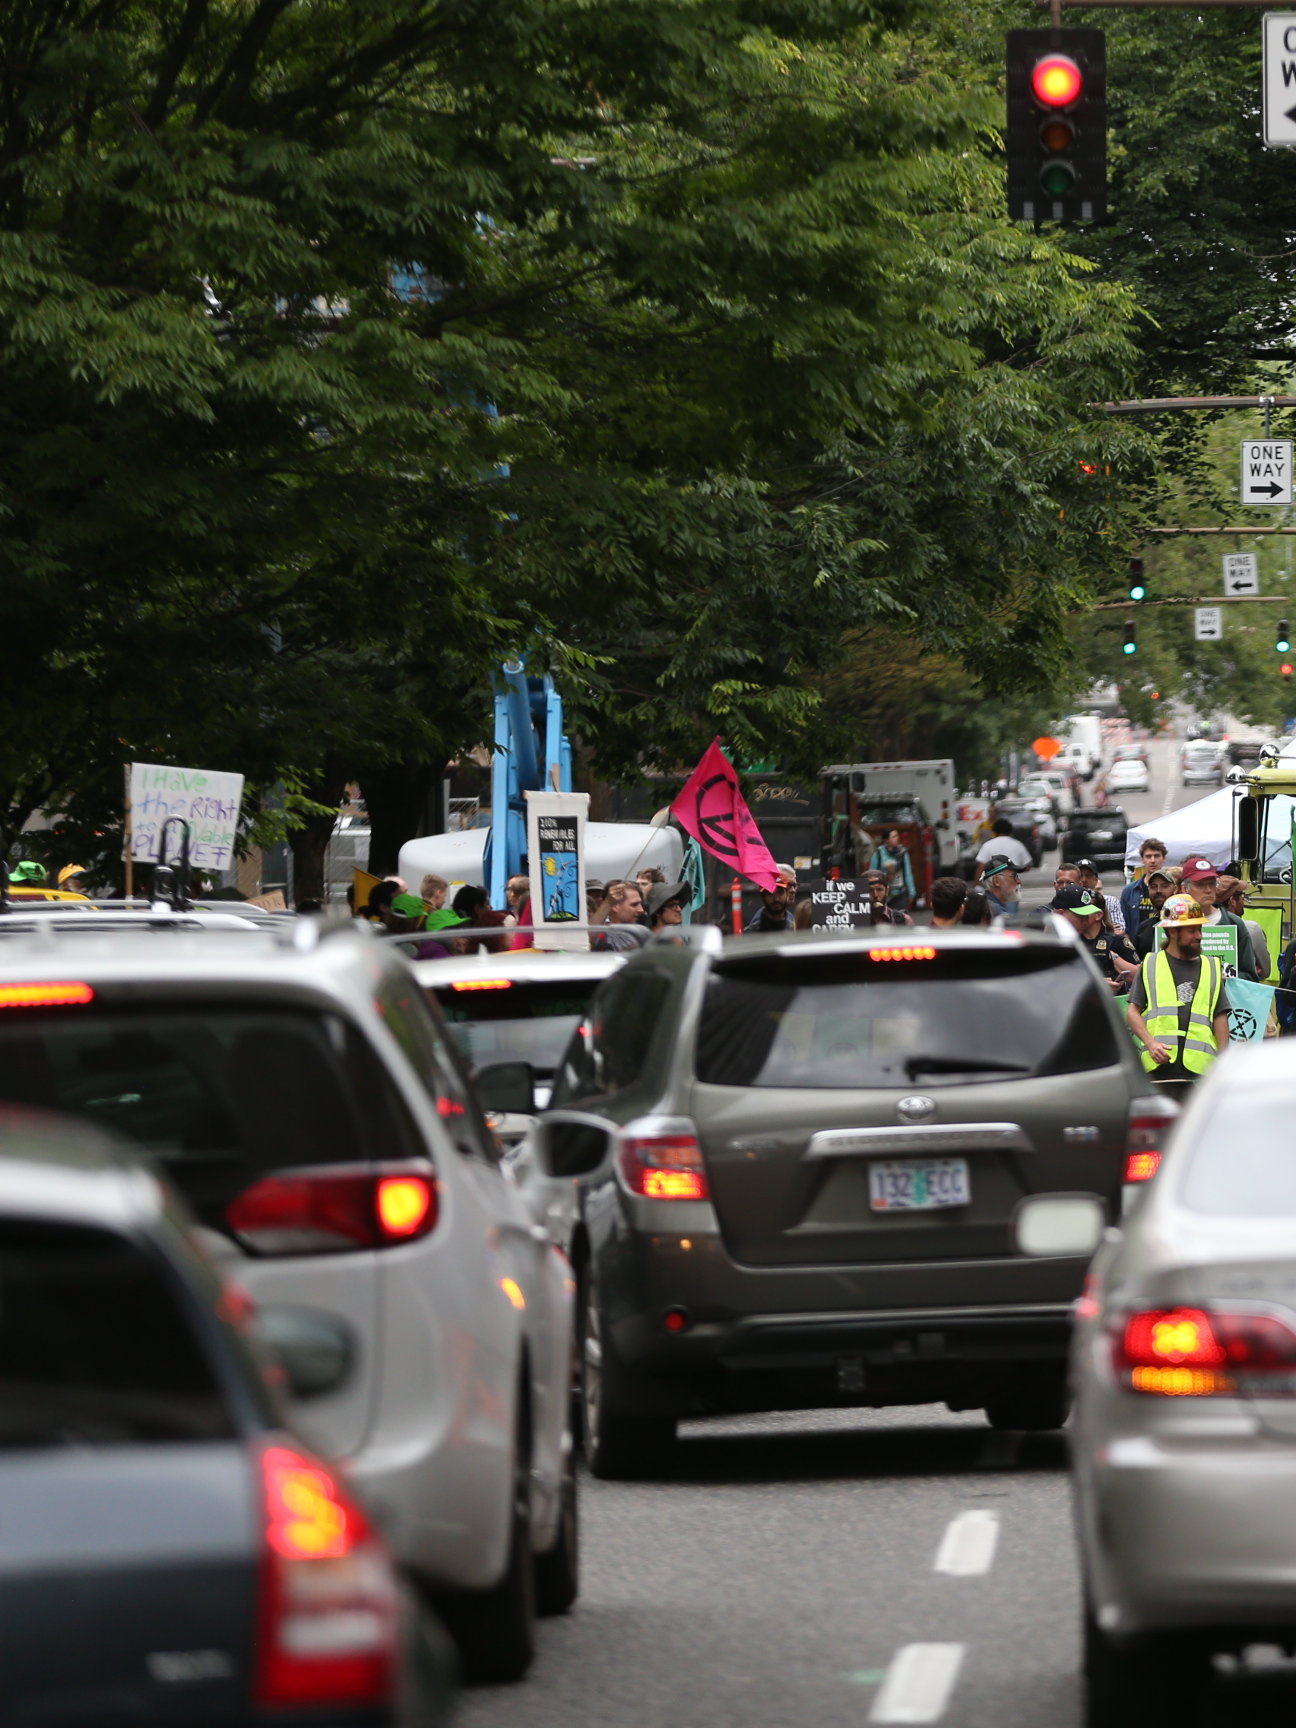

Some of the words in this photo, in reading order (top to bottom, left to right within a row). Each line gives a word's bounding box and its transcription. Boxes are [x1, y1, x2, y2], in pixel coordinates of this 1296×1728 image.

[1251, 446, 1284, 460] ONE
[1249, 463, 1285, 477] WAY
[142, 768, 148, 789] I
[137, 792, 187, 815] the
[826, 880, 834, 891] if
[836, 881, 855, 892] we
[812, 892, 846, 904] KEEP
[833, 901, 871, 914] CALM
[825, 912, 850, 925] and
